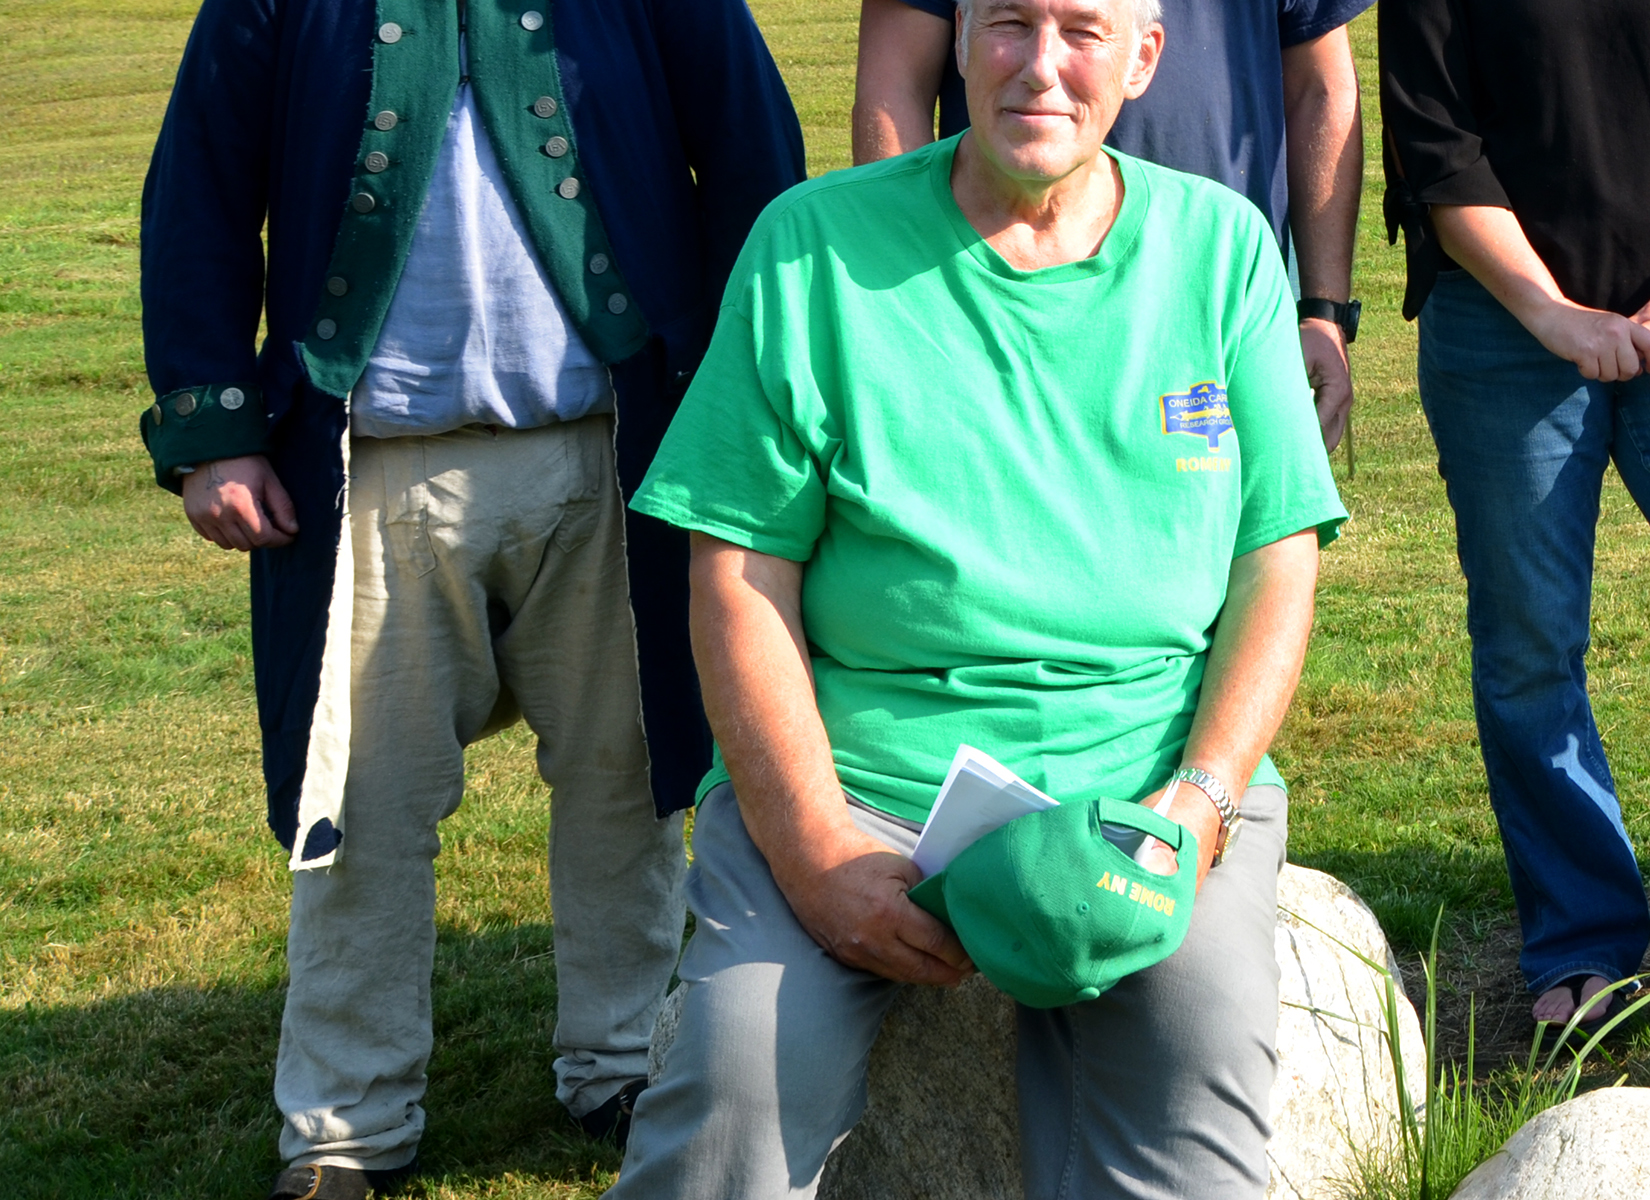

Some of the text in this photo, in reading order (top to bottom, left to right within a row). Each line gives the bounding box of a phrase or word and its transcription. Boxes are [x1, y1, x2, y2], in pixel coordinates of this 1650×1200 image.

[1168, 396, 1207, 408] ONEIDA
[1179, 418, 1217, 429] RESEARCH
[1096, 871, 1176, 917] ROME NY
